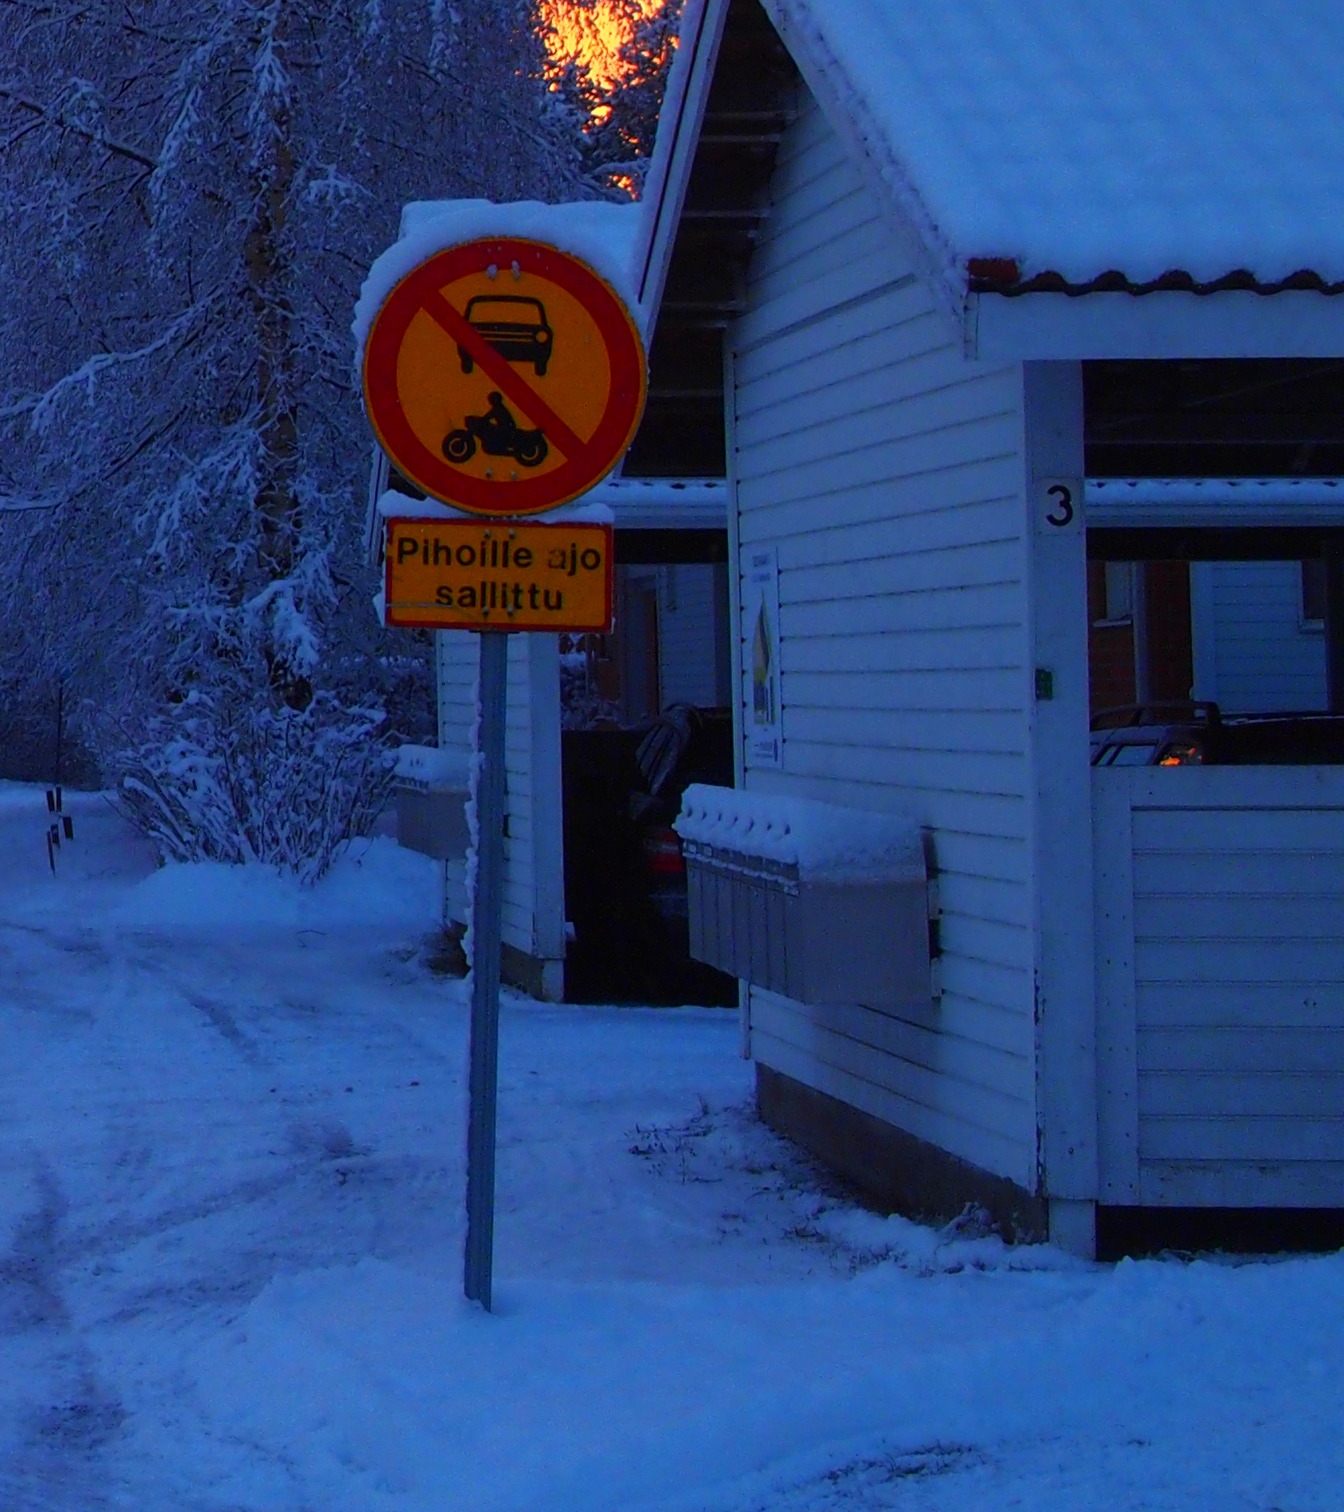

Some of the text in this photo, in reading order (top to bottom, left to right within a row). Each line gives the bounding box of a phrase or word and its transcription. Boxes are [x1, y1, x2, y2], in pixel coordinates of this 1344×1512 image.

[1046, 484, 1073, 527] 3
[397, 537, 601, 576] Pihoille ajo
[435, 581, 563, 611] sallittu
